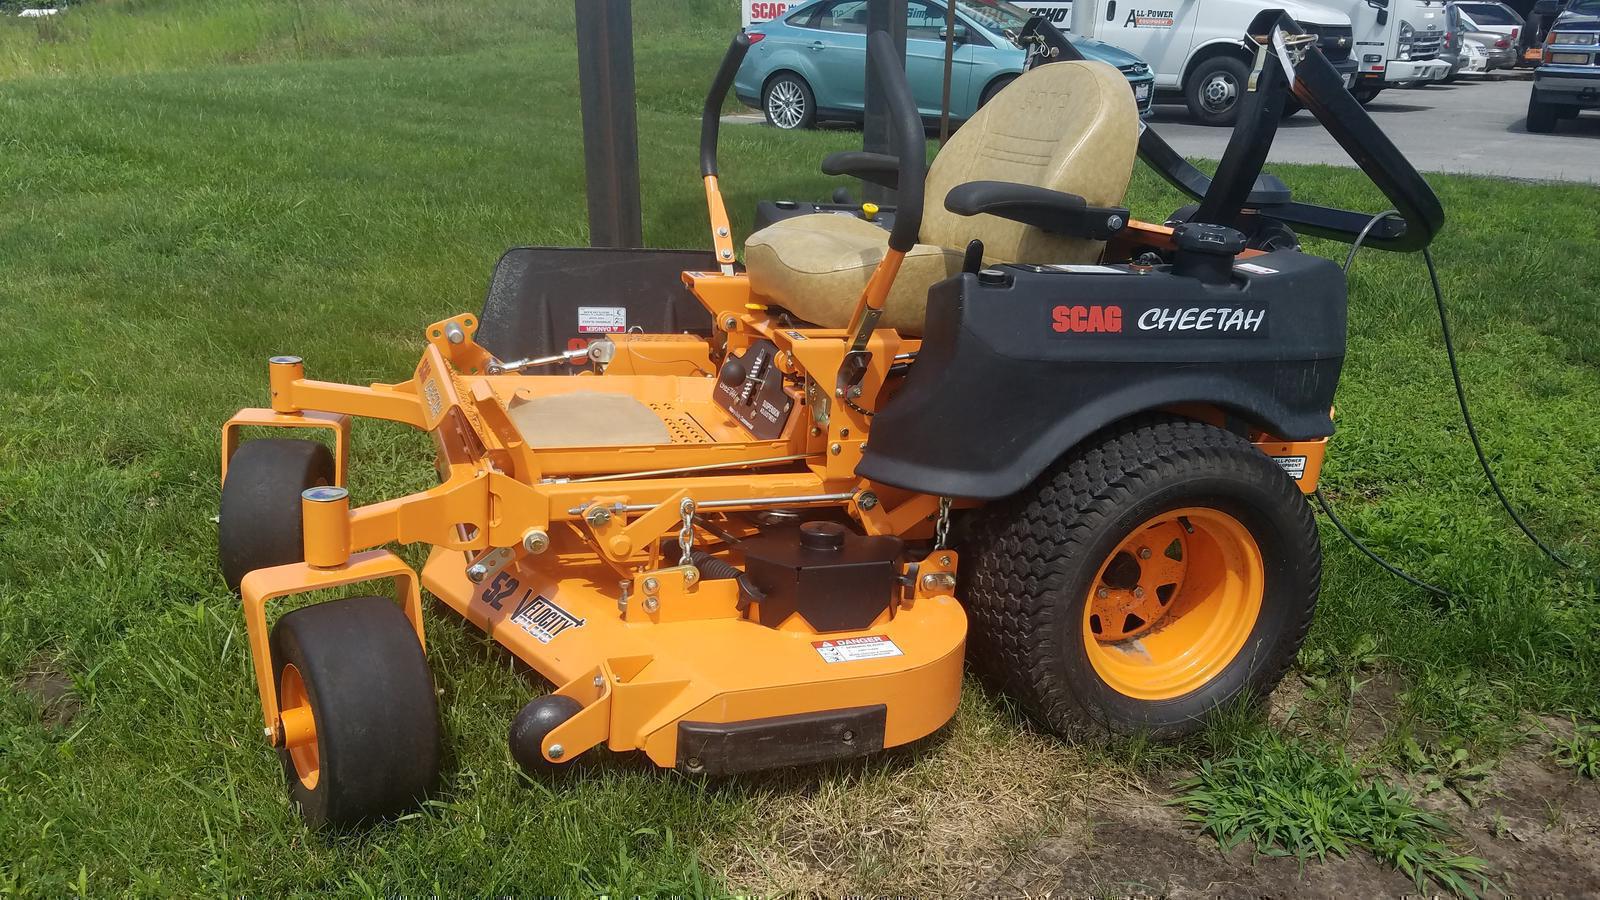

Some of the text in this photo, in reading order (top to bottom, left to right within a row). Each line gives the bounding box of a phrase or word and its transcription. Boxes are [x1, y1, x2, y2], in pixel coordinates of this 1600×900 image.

[751, 2, 786, 19] SCAG
[1052, 305, 1266, 333] SCAG CHEETAH
[481, 571, 585, 637] 52 VELOCITY
[836, 636, 882, 646] DANGER
